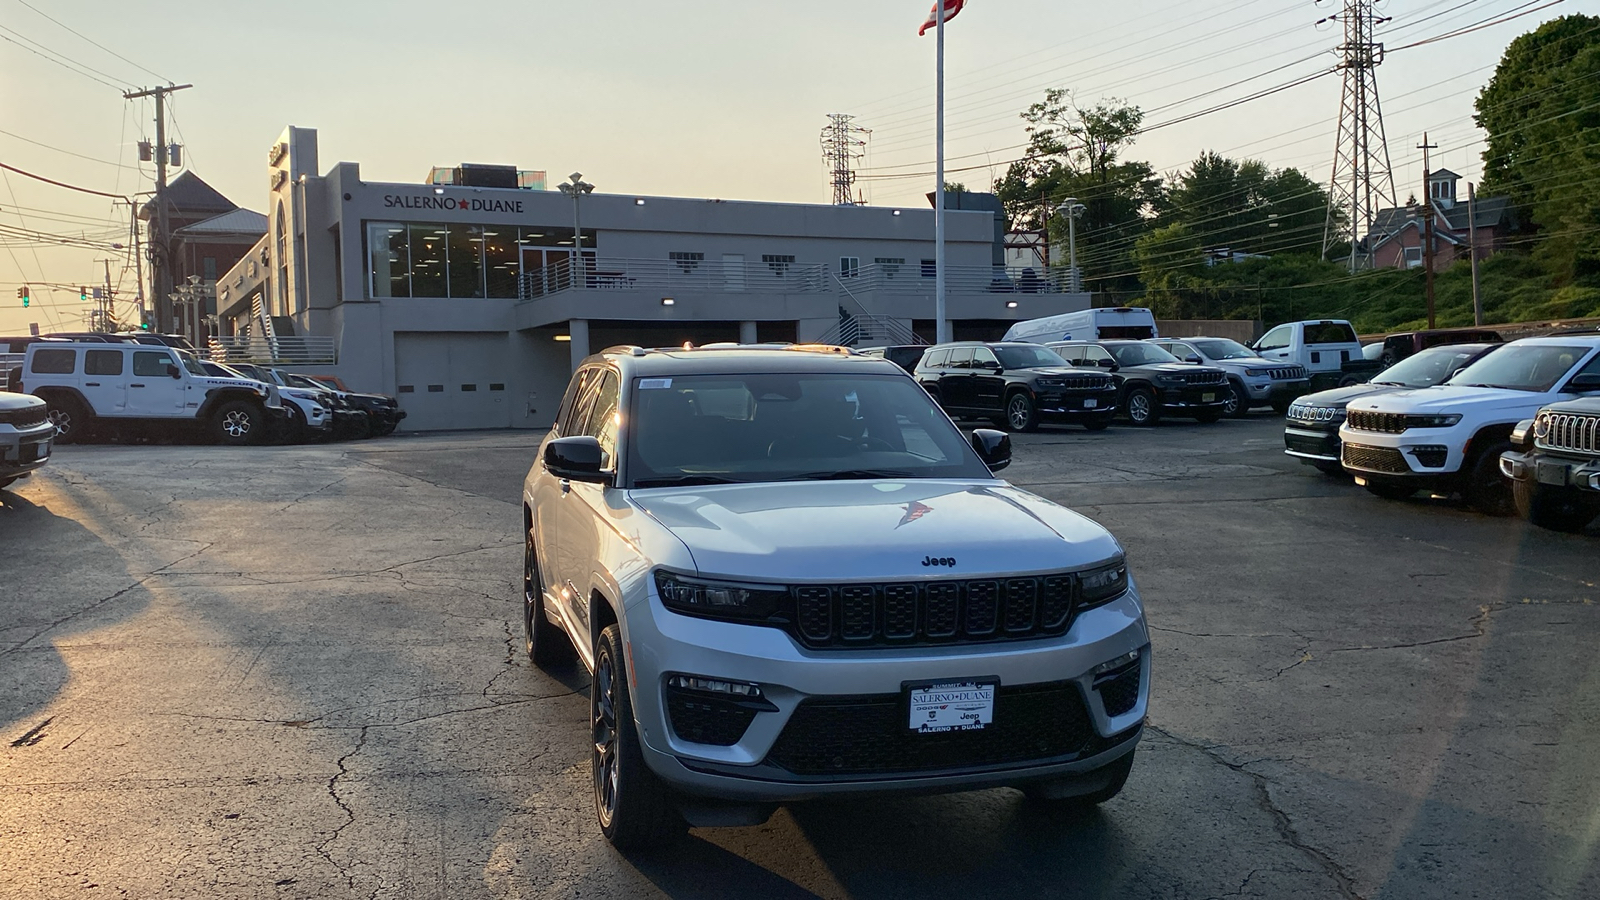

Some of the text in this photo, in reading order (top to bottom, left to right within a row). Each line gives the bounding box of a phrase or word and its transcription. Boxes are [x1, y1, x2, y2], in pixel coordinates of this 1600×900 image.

[384, 195, 524, 213] SALERNO DUANE
[921, 555, 957, 568] Jeep
[912, 691, 992, 703] SALERNO DUANE
[960, 712, 980, 720] Jeep
